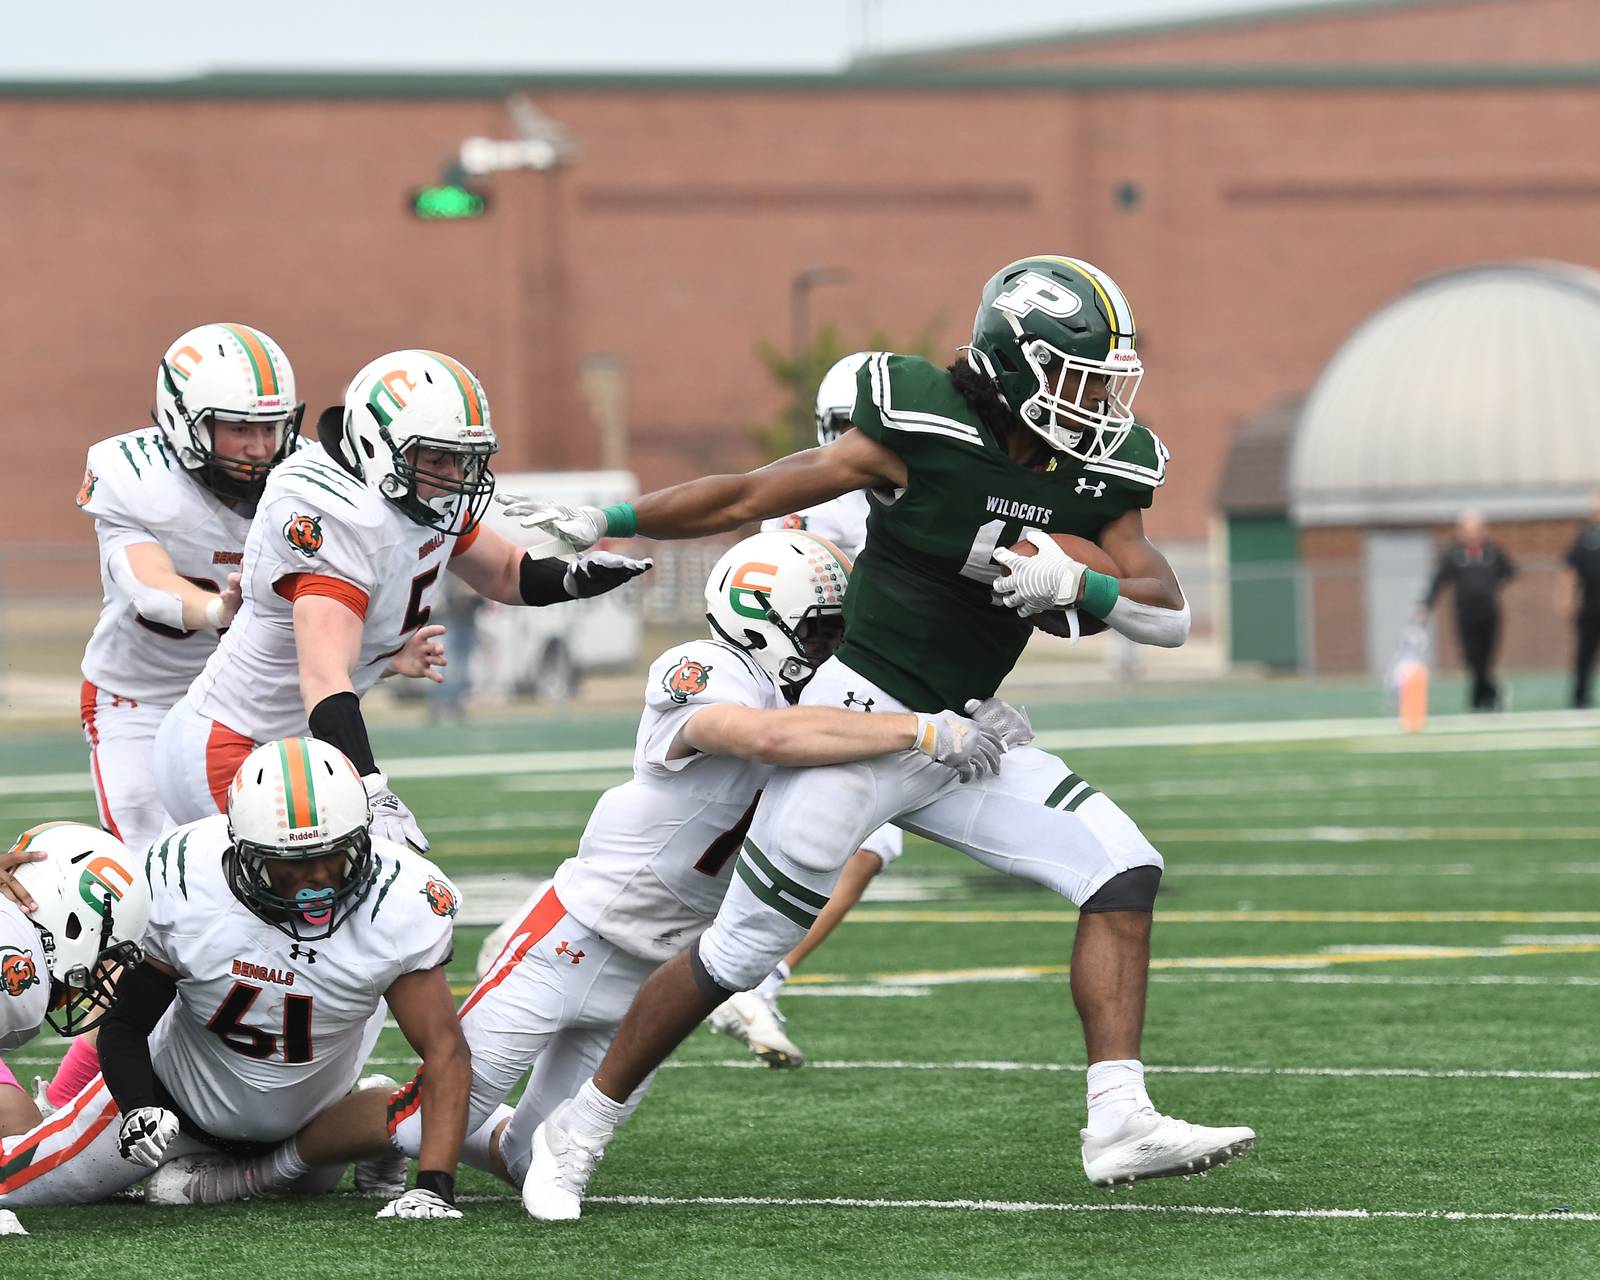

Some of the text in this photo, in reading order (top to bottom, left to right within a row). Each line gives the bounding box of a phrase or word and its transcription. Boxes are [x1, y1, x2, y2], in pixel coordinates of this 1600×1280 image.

[992, 271, 1082, 319] P
[986, 496, 1053, 525] WILDCATS
[289, 829, 319, 841] Riddell
[231, 959, 295, 986] BENGALS
[206, 980, 314, 1063] 61
